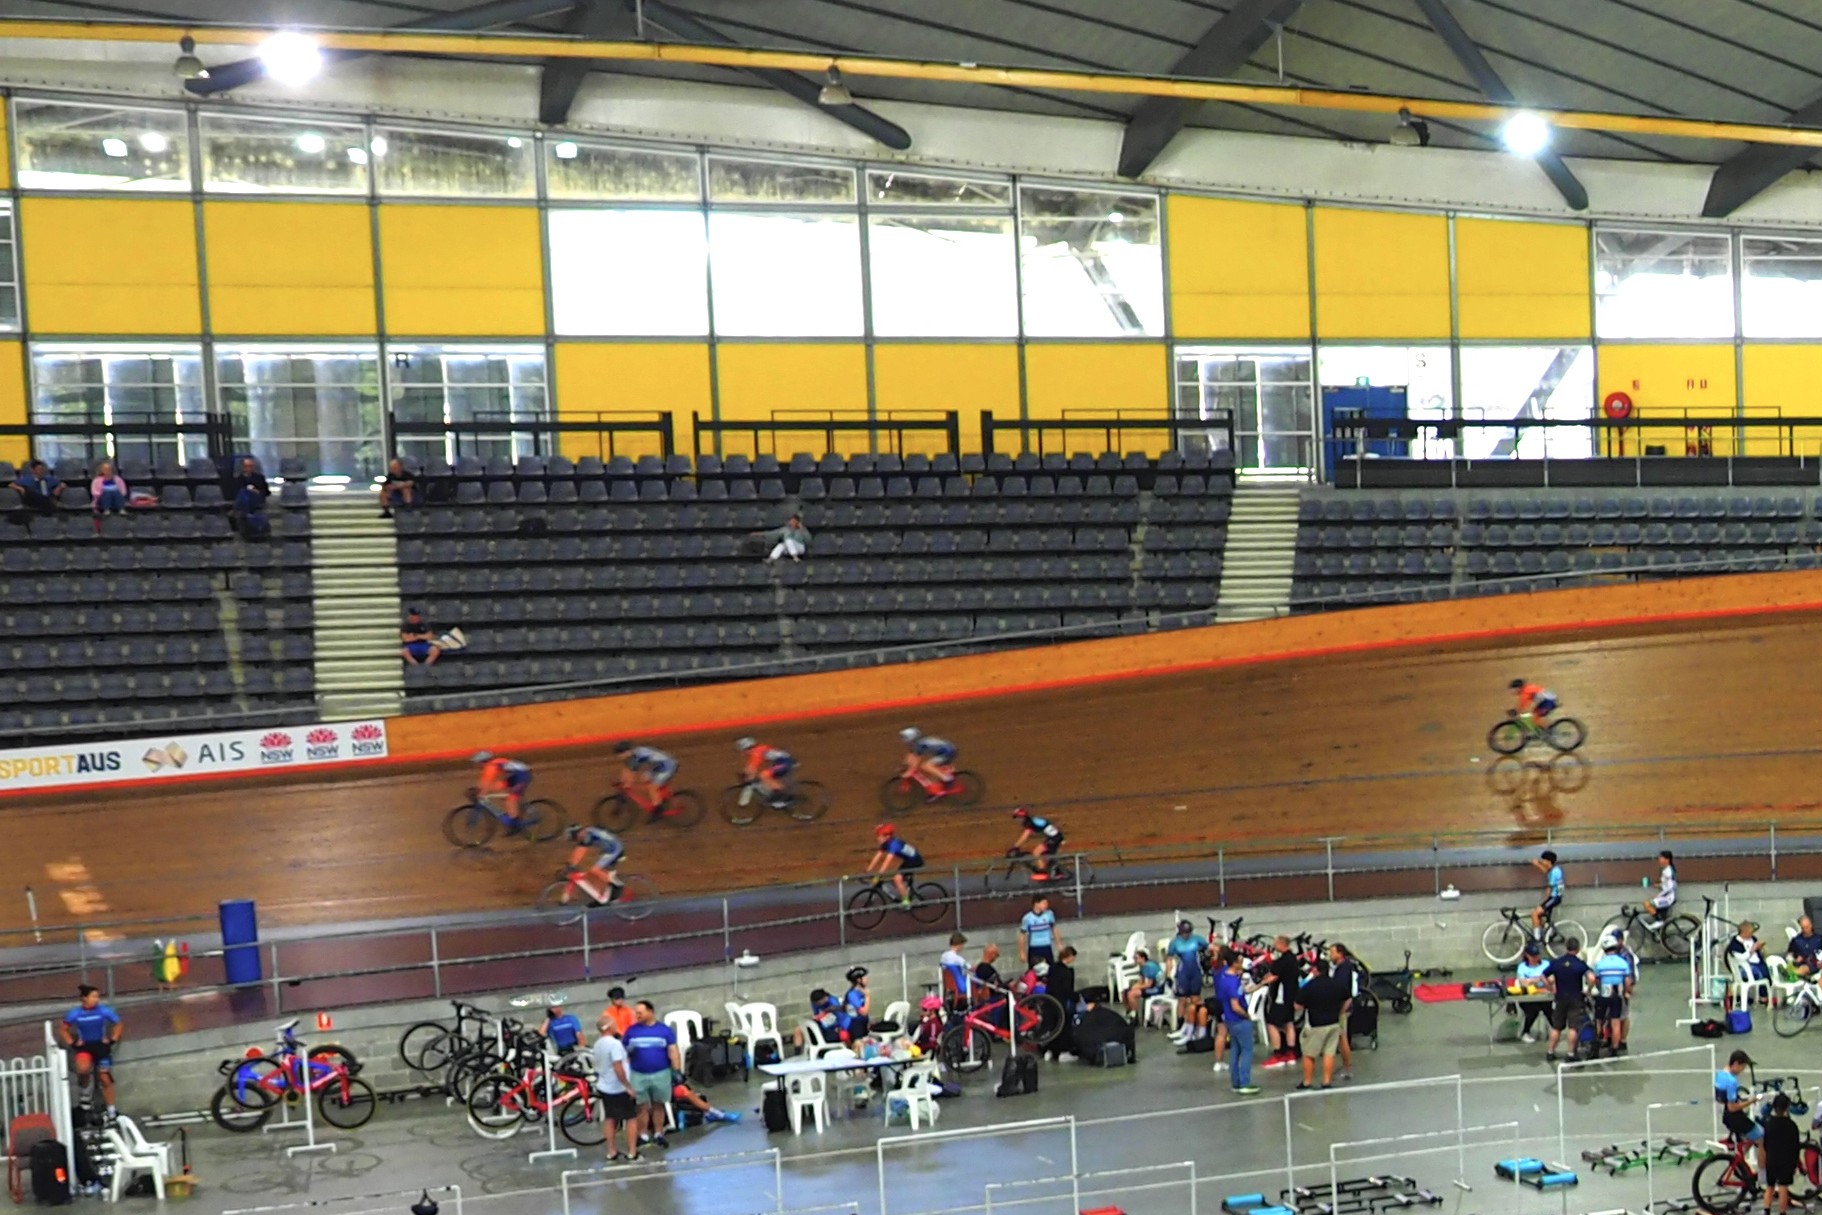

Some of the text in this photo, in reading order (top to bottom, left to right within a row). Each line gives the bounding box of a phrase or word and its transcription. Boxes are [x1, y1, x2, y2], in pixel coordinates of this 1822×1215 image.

[199, 741, 245, 764] AIS
[307, 745, 339, 758] NSW
[352, 741, 384, 754] NSW
[261, 749, 294, 762] NSW
